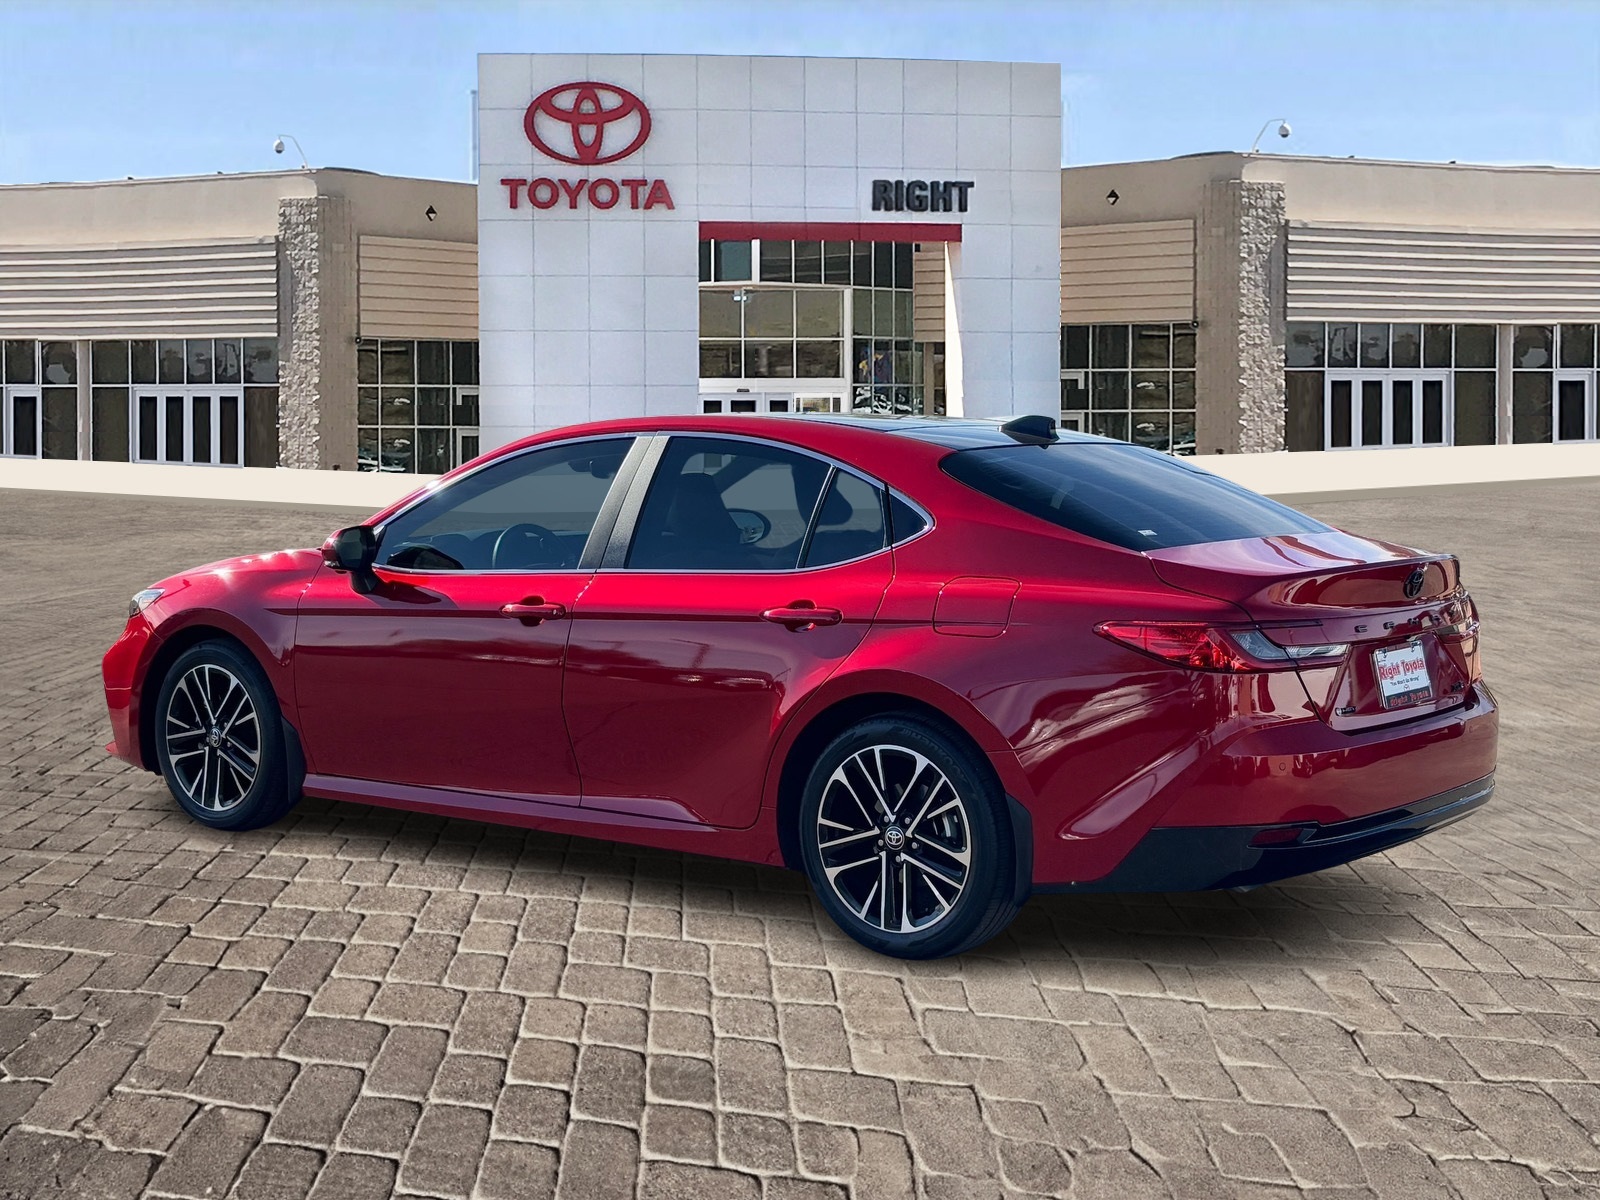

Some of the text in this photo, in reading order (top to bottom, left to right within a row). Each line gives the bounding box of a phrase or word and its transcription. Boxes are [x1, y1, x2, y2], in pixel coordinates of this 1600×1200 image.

[500, 178, 675, 210] TOYOTA
[872, 179, 975, 212] RIGHT
[1378, 658, 1425, 681] Right Toyota
